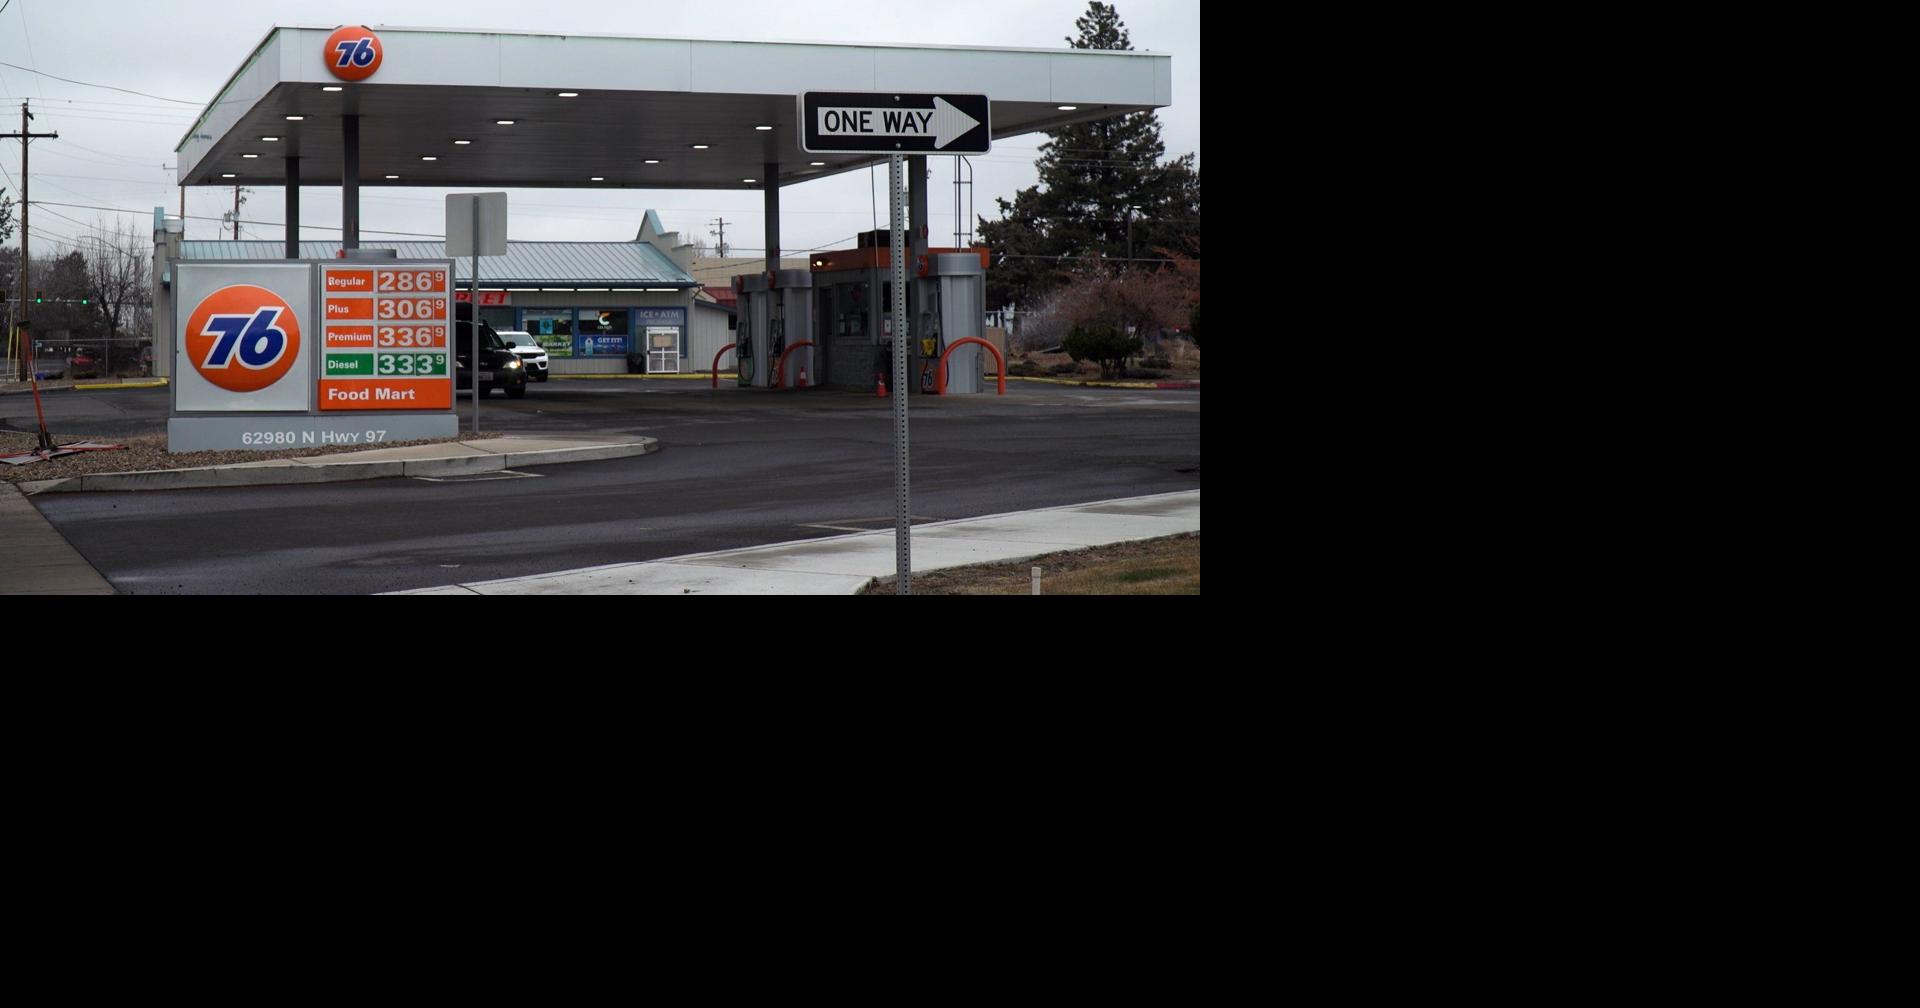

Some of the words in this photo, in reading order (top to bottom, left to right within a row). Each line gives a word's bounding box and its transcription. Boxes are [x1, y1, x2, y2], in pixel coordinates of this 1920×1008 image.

[335, 37, 375, 67] 76
[824, 110, 873, 132] ONE
[883, 111, 933, 133] WAY
[328, 276, 366, 287] Regular
[328, 304, 349, 313] Plus
[640, 311, 653, 319] ICE
[660, 311, 679, 319] ATM
[200, 306, 288, 370] 76
[328, 332, 372, 341] Premium
[328, 360, 358, 369] Diesel
[328, 388, 369, 400] Food
[375, 388, 415, 400] Mart
[242, 432, 295, 444] 62980
[302, 431, 315, 443] N
[365, 430, 387, 443] 97
